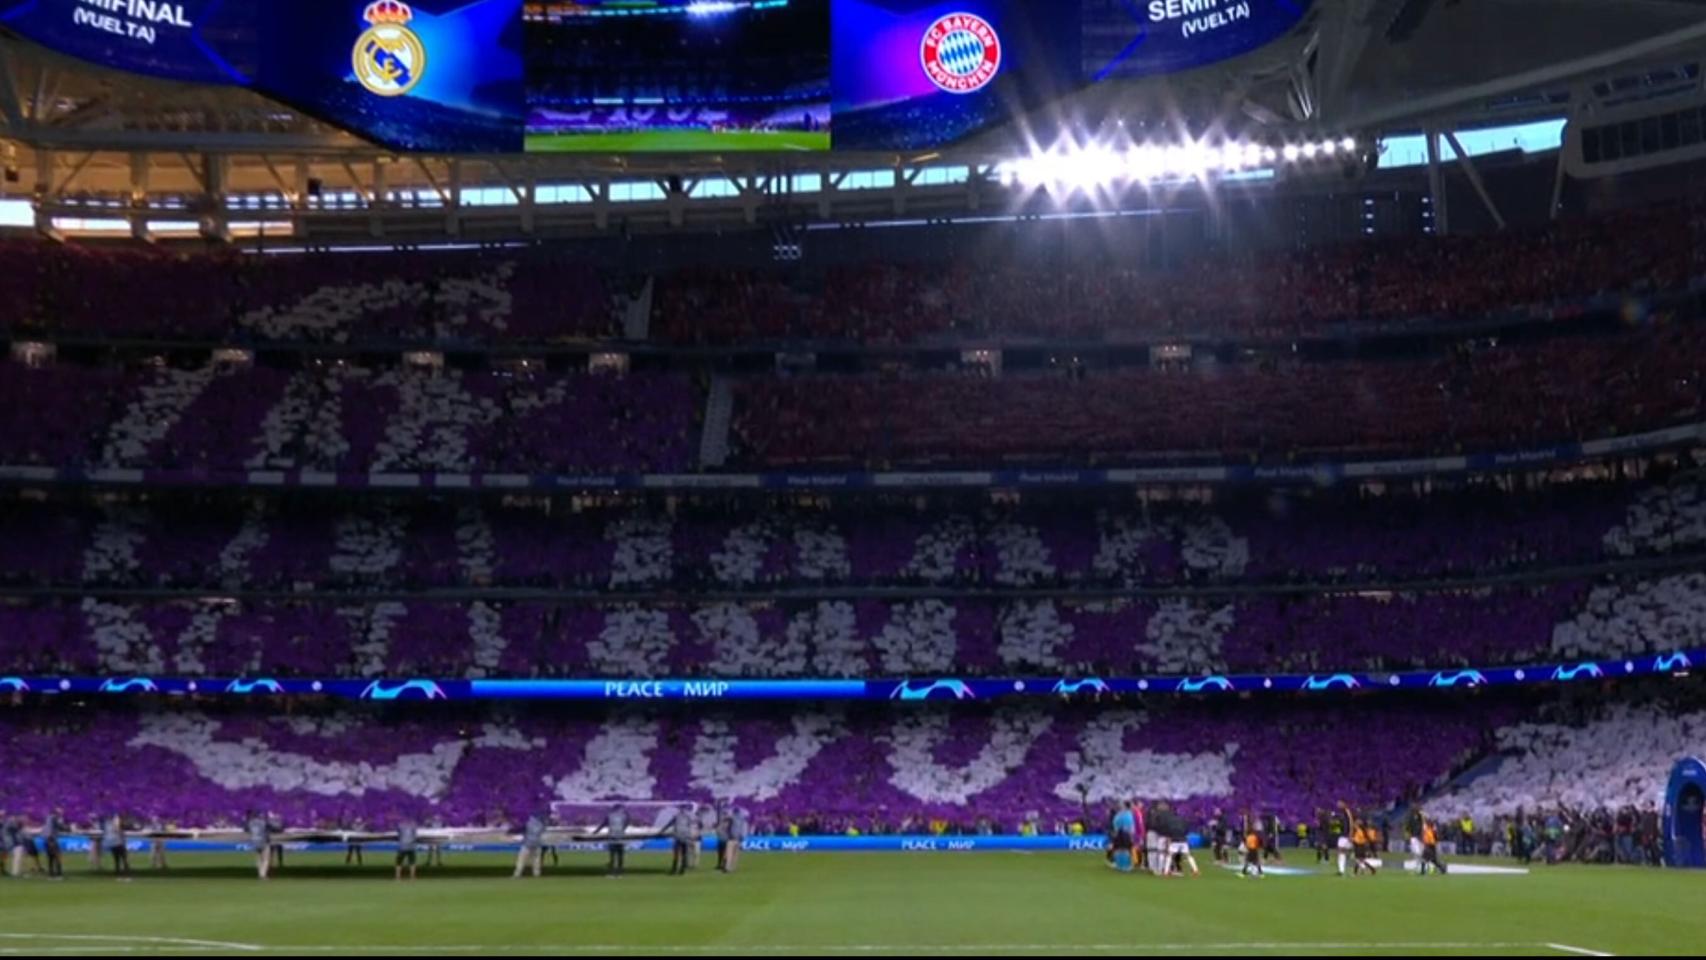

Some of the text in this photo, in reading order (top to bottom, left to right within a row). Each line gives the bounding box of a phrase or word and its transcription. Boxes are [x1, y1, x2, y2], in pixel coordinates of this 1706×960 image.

[73, 6, 156, 44] (VUELTA)
[1182, 1, 1250, 39] (VUELTA)
[605, 681, 664, 697] PEACE
